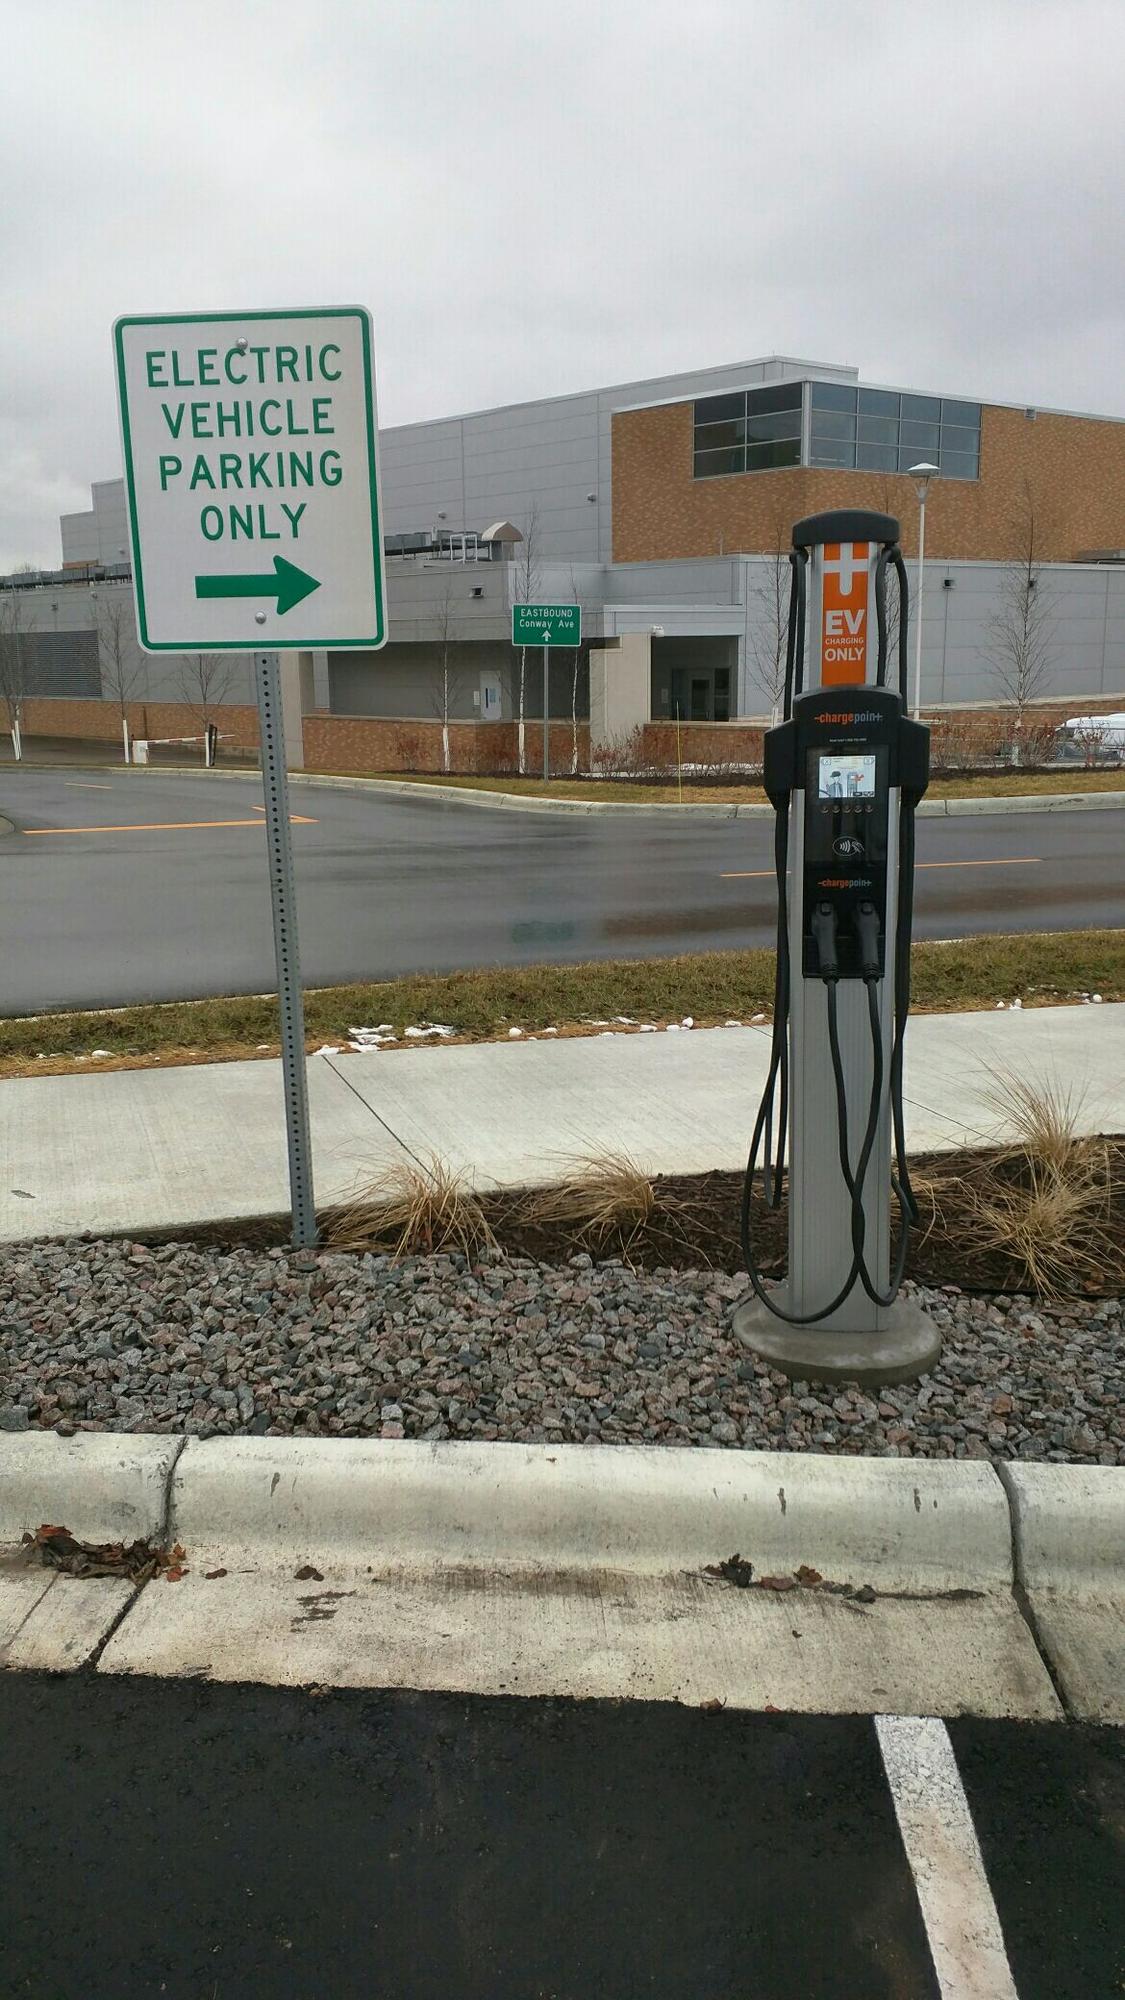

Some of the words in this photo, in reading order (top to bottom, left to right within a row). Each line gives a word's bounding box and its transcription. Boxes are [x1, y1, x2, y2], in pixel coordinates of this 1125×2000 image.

[146, 344, 342, 388] ELECTRIC
[161, 398, 335, 439] VEHICLE
[159, 450, 343, 491] PARKING
[201, 503, 307, 541] ONLY
[519, 619, 553, 629] Conway
[558, 620, 575, 628] Ave
[520, 608, 573, 618] EASTBOUND
[825, 609, 865, 635] EV
[824, 647, 865, 662] ONLY
